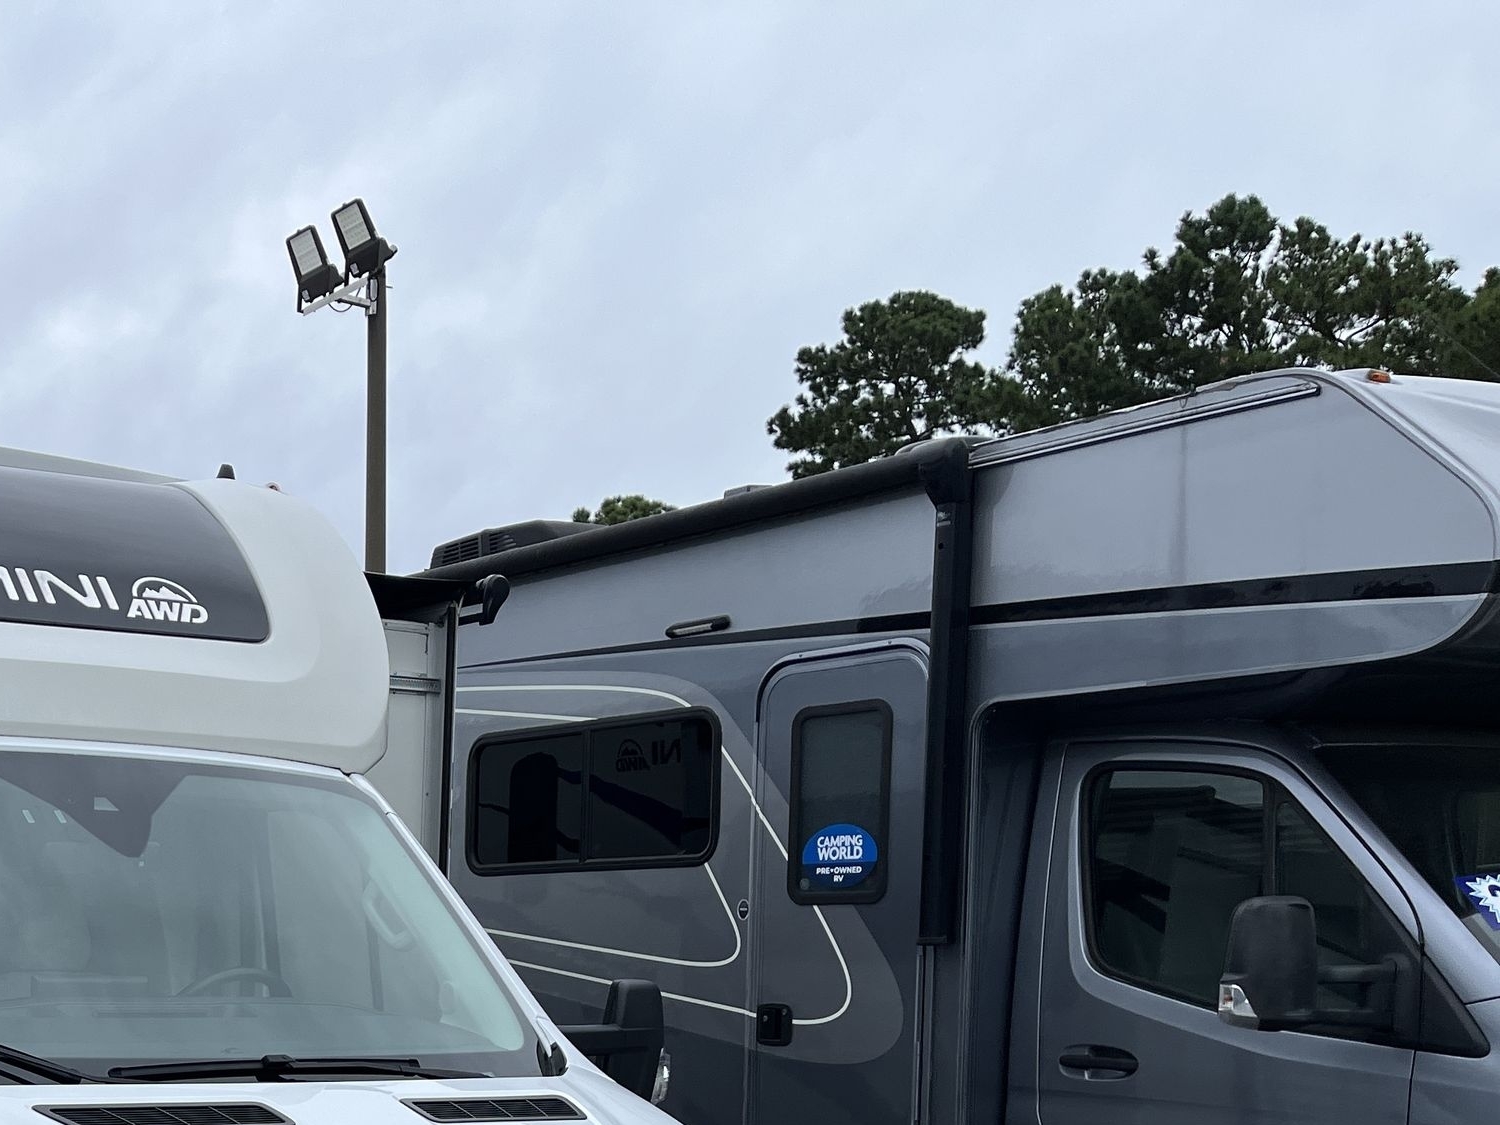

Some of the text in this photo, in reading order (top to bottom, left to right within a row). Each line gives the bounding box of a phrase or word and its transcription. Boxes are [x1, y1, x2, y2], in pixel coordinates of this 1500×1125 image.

[127, 598, 208, 624] AWD
[817, 835, 863, 847] CAMPING
[817, 846, 863, 861] WORLD
